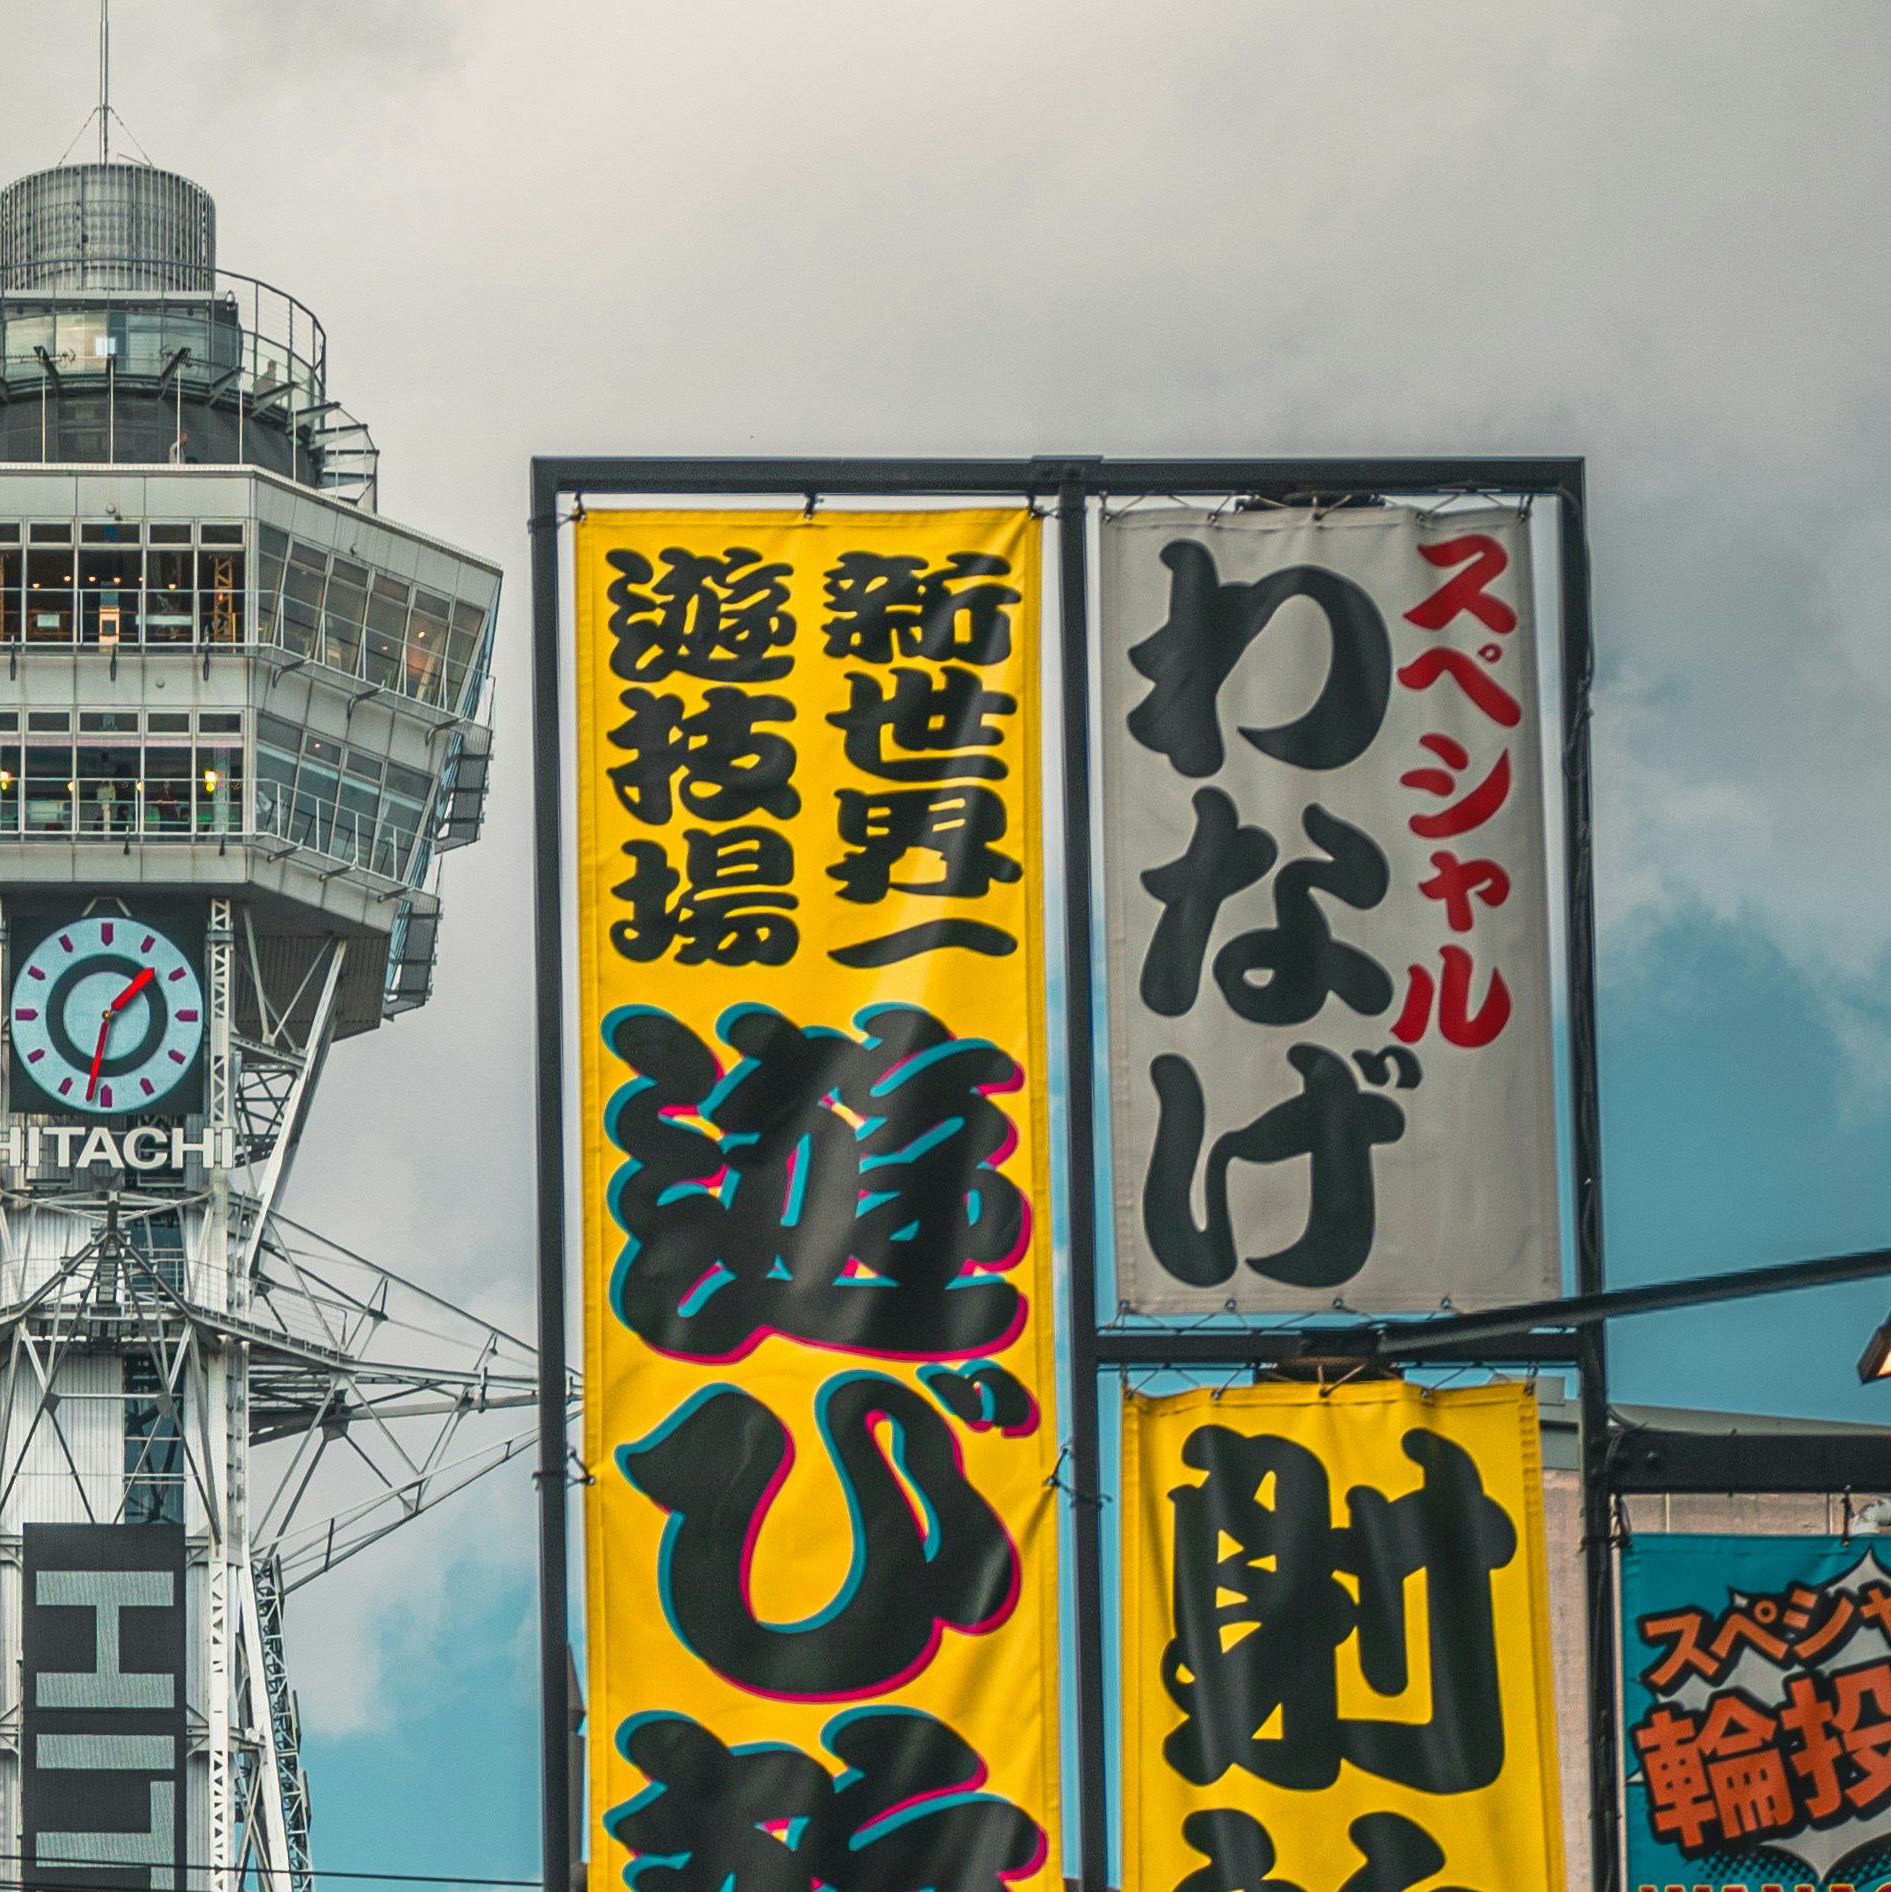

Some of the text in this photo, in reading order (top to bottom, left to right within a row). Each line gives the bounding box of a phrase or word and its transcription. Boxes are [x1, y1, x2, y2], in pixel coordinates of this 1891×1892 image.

[606, 546, 801, 968] 遊技場
[1126, 537, 1424, 1289] わなげ
[1390, 533, 1522, 1048] スペシャル
